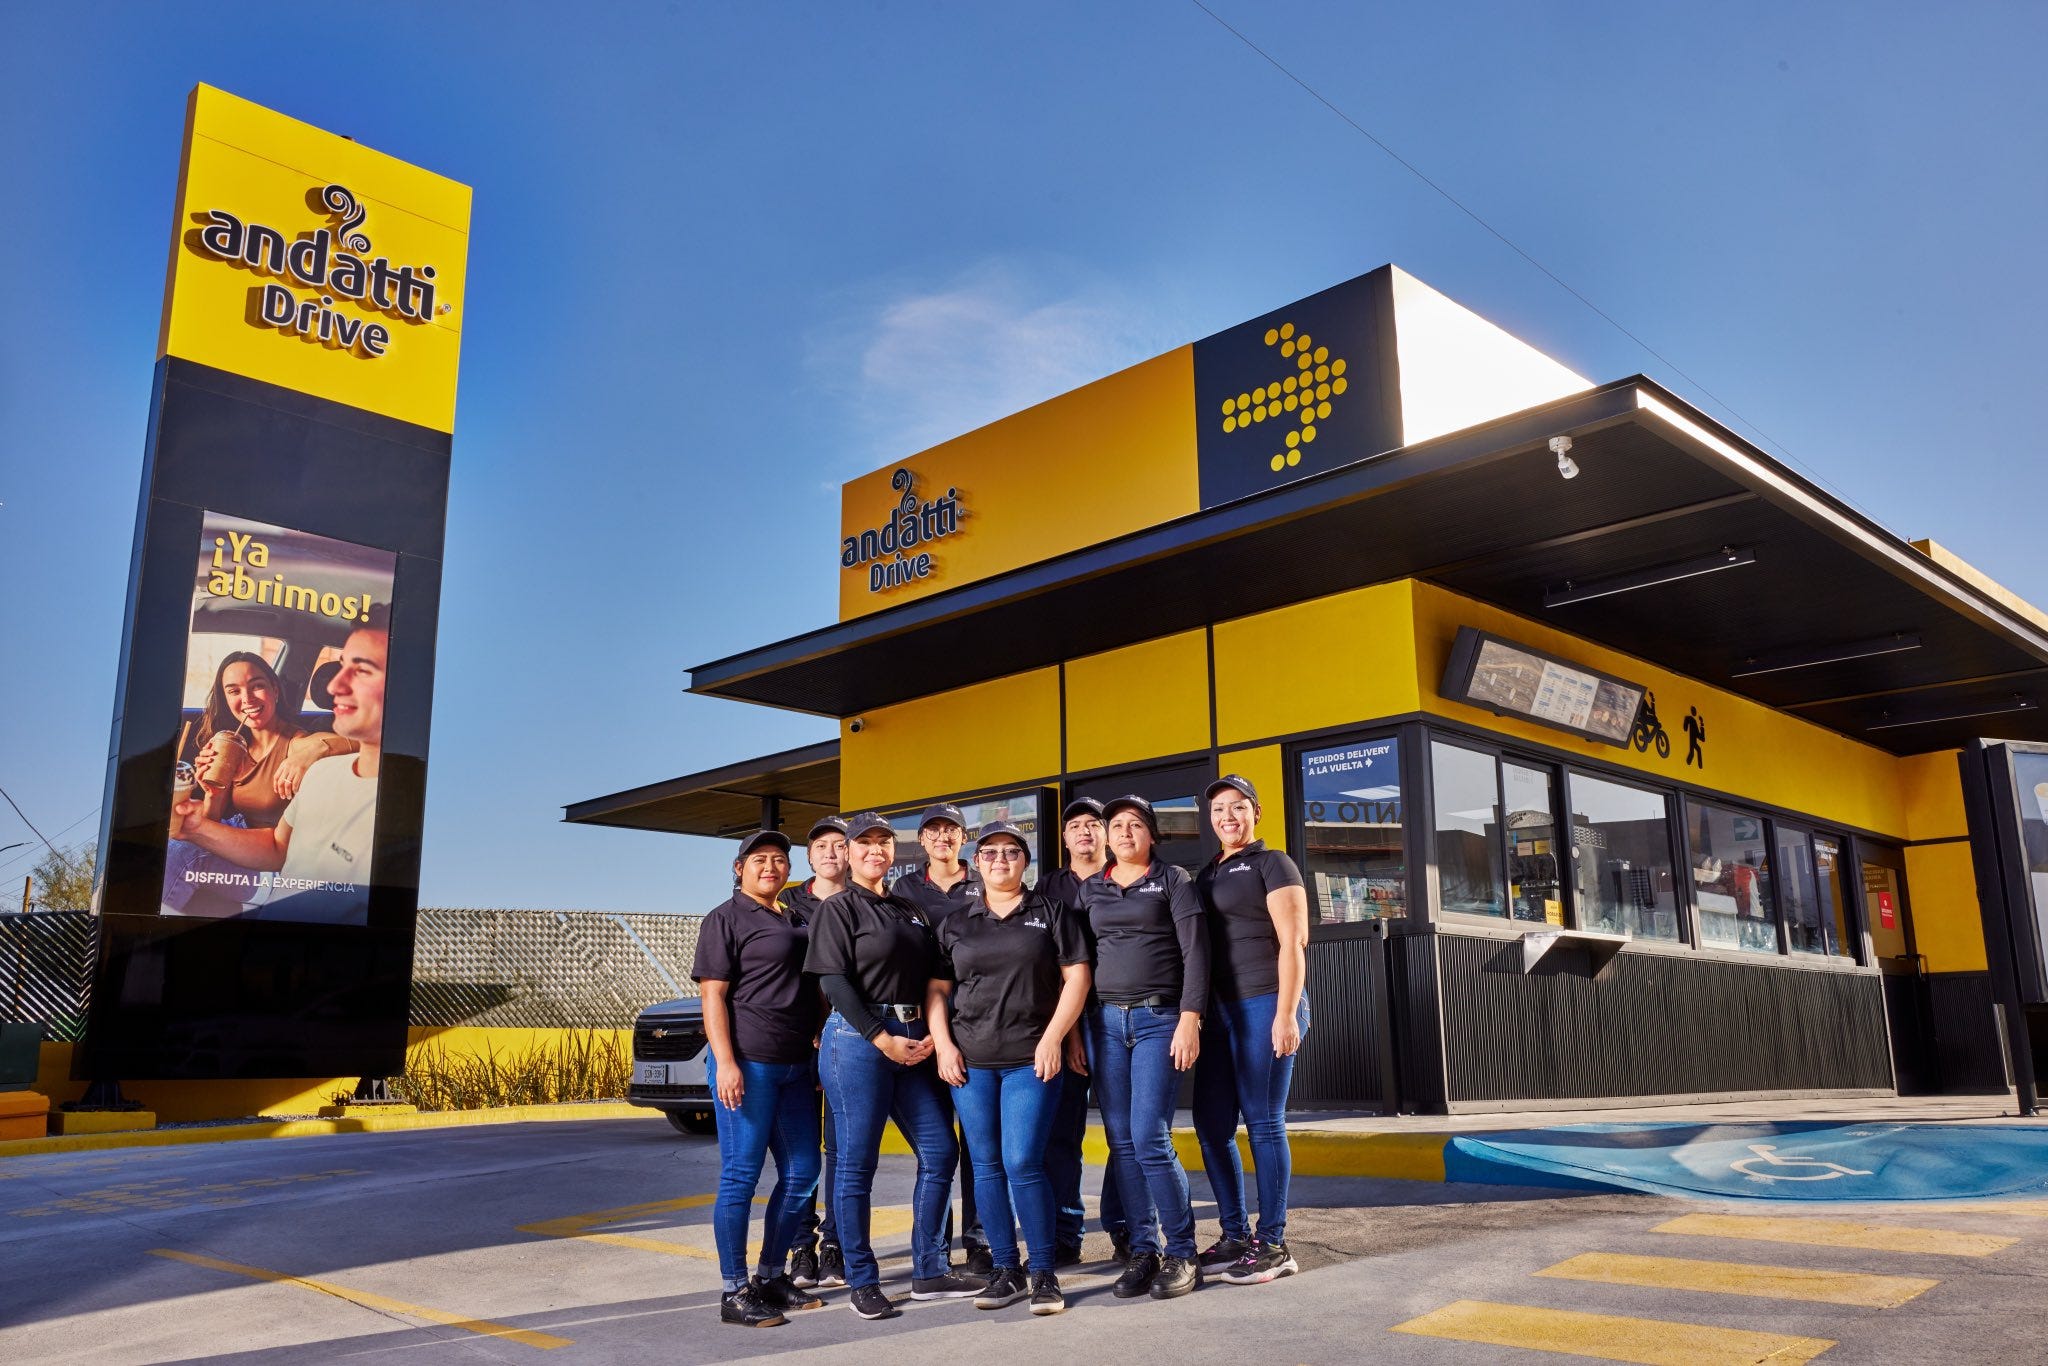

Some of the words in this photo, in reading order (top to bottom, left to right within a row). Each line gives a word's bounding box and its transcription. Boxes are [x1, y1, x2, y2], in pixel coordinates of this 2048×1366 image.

[202, 209, 435, 323] andatti
[263, 283, 389, 356] Drive
[841, 487, 957, 567] andatti
[212, 531, 269, 568] ¡Ya
[869, 552, 930, 593] Drive
[207, 565, 372, 623] abrimos!
[1308, 752, 1345, 766] PEDIDOS
[1346, 745, 1390, 760] DELIVERY
[1308, 767, 1315, 776] A
[1316, 765, 1328, 775] LA
[1329, 760, 1363, 773] VUELTA
[184, 870, 250, 886] DISFRUTA
[253, 875, 270, 888] LA
[272, 877, 355, 893] EXPERIENCIA
